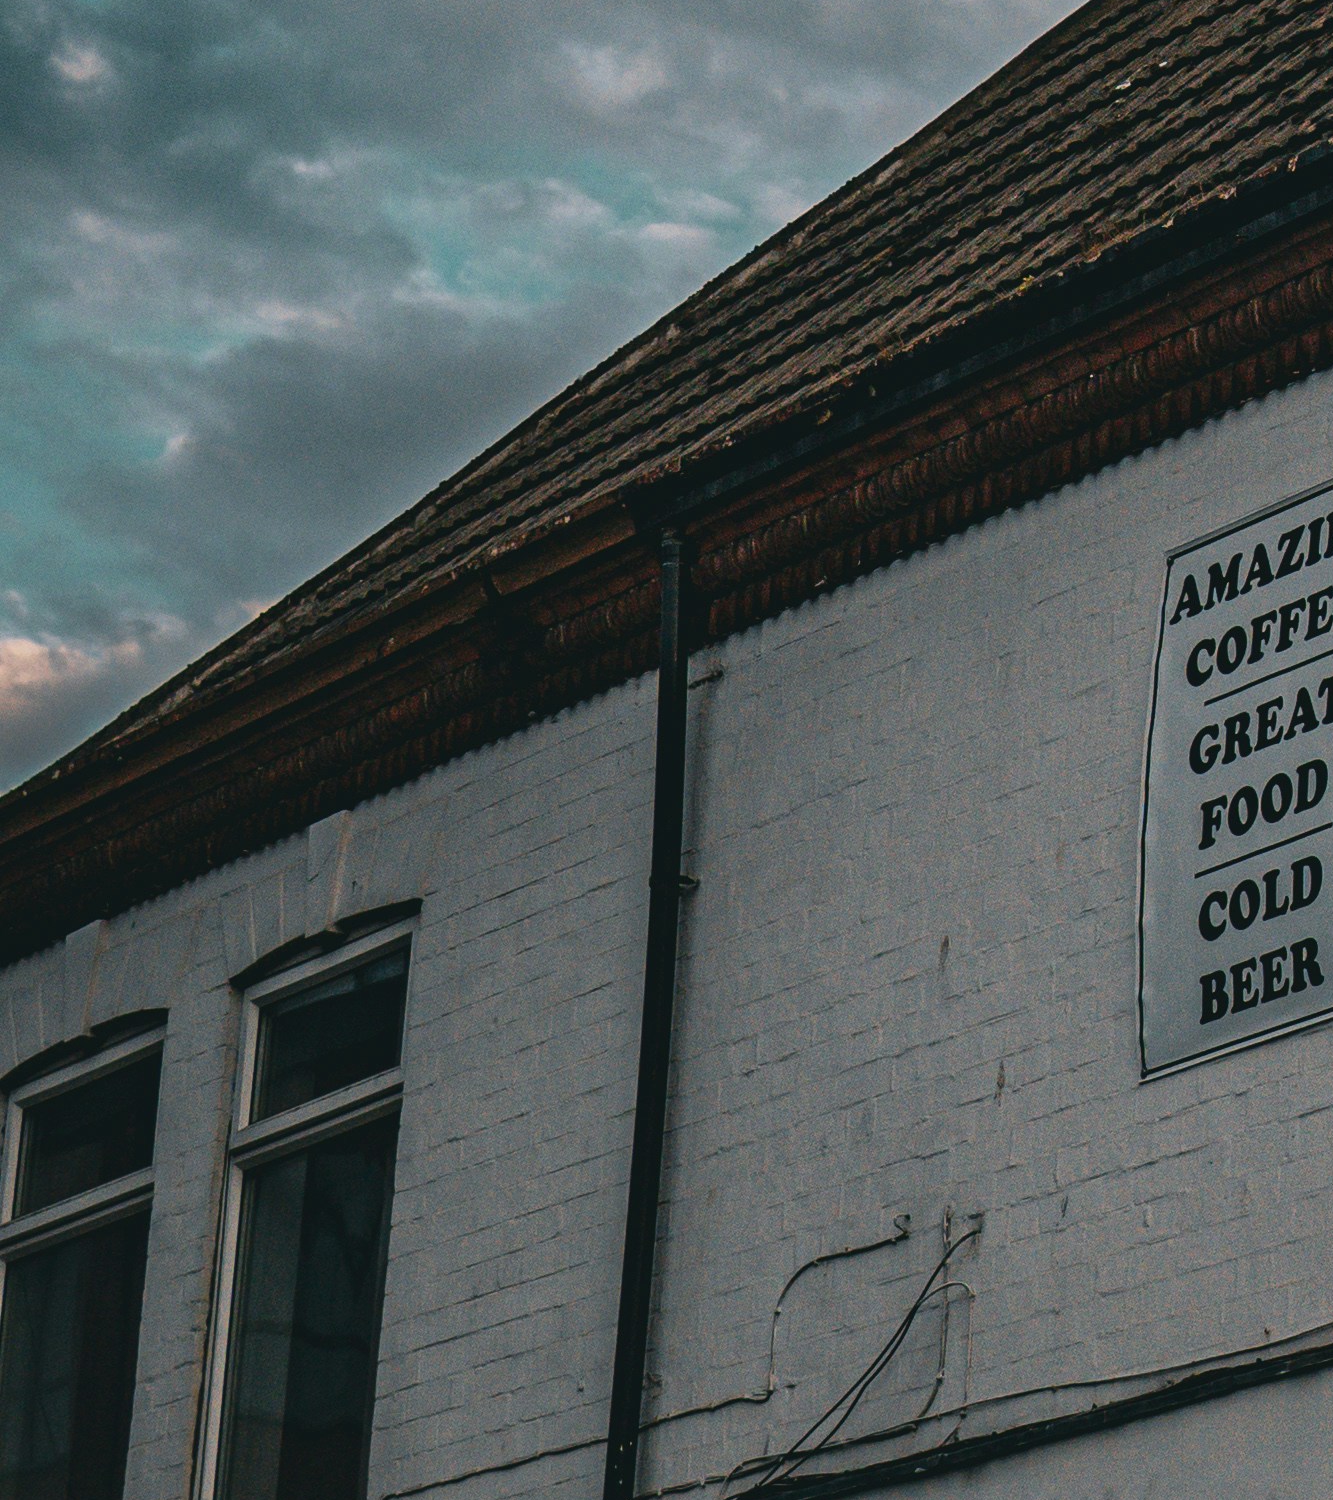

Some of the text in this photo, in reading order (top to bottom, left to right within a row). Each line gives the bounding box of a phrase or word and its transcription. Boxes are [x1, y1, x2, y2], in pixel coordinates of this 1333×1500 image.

[1198, 759, 1328, 851] FOOD
[1199, 855, 1323, 942] COLD
[1199, 937, 1325, 1026] BEER
